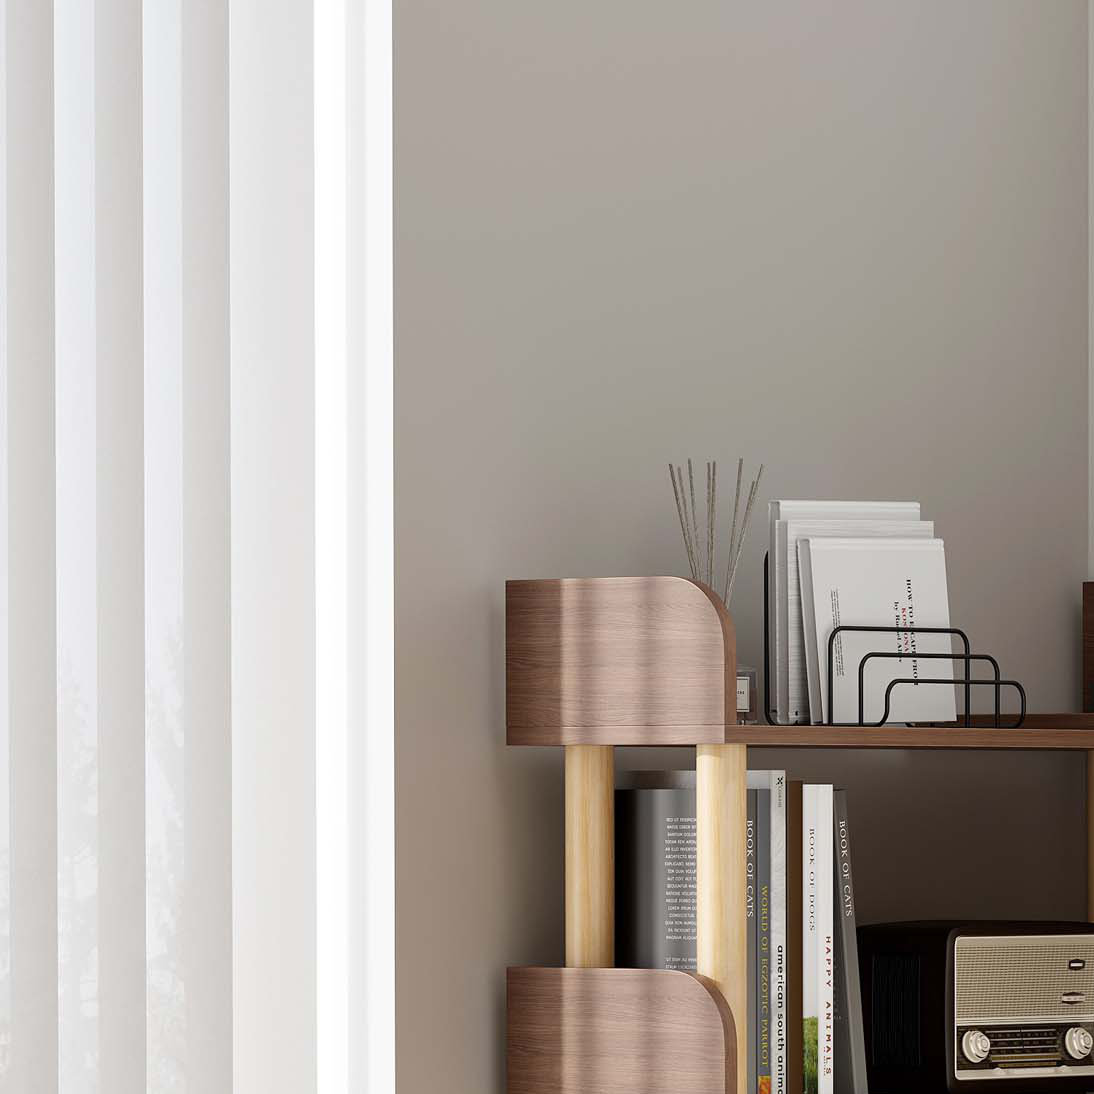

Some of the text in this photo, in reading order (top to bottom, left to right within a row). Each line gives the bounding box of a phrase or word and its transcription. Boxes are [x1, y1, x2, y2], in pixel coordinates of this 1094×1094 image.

[908, 606, 914, 618] TO
[747, 862, 754, 880] OF
[809, 871, 815, 888] OF
[839, 820, 853, 917] BOOK OF CATS
[761, 885, 769, 932] WORLD
[761, 936, 769, 953] OF
[777, 945, 785, 1009] american
[761, 1019, 769, 1067] PARROT
[777, 1014, 785, 1051] south
